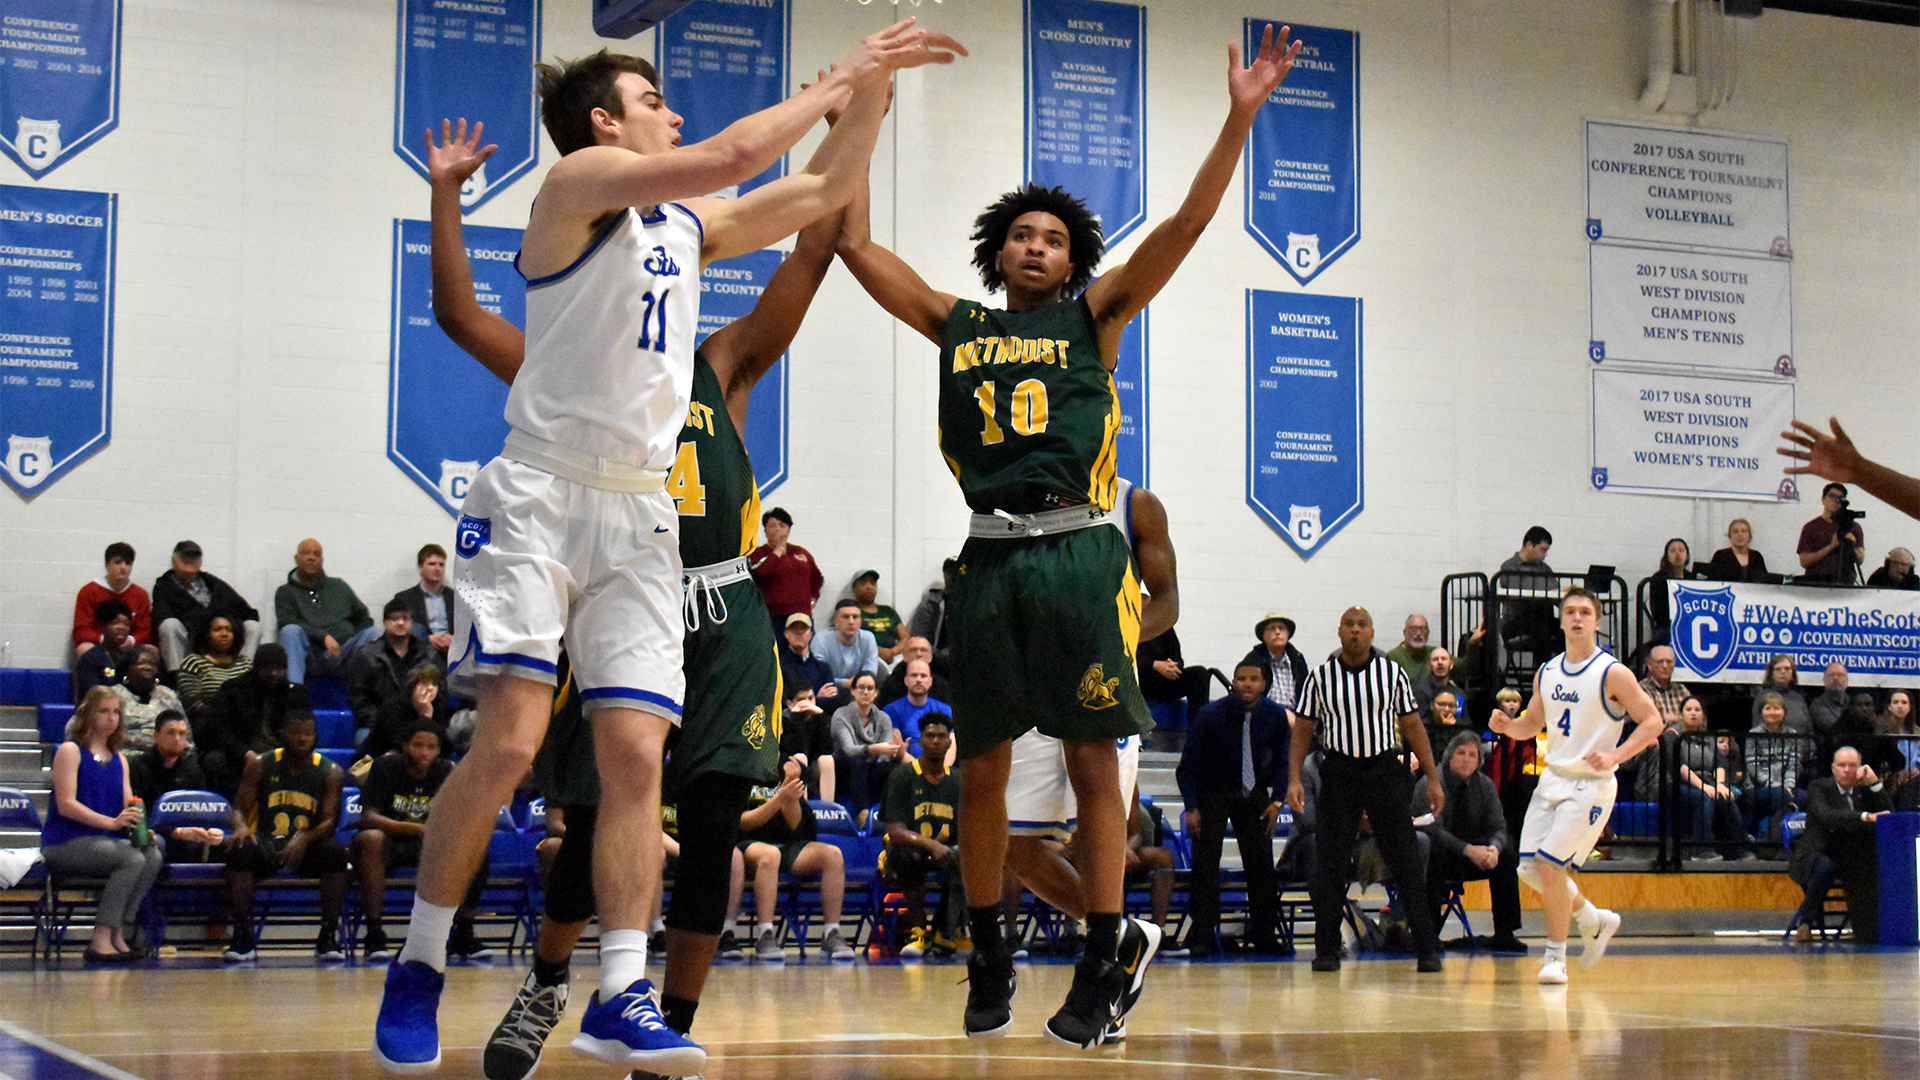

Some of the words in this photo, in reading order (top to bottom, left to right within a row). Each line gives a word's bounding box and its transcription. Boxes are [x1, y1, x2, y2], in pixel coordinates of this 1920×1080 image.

[717, 0, 775, 8] NTRY
[4, 16, 79, 32] CONFERENCE
[690, 22, 755, 37] CONFERENCE
[1068, 20, 1104, 31] MEN'S
[2, 28, 81, 44] TOURNAMENT
[683, 31, 762, 48] CHAMPIONSHIPS
[1039, 30, 1075, 43] CROSS
[1078, 34, 1132, 48] COUNTRY
[77, 63, 102, 75] 2014
[1063, 62, 1106, 74] NATIONAL
[1292, 59, 1336, 72] ETBALL
[1052, 71, 1117, 85] CHAMPIONSHIP
[1054, 82, 1116, 96] APPEARANCES
[1274, 86, 1328, 99] CONFERENCE
[1268, 95, 1336, 110] CHAMPIONSHIPS
[28, 134, 48, 159] C
[1633, 143, 1664, 157] 2017
[1667, 146, 1694, 161] USA
[1699, 149, 1745, 166] SOUTH
[1275, 159, 1330, 172] CONFERENCE
[1273, 169, 1331, 182] TOURNAMENT
[1591, 159, 1685, 181] CONFERENCE
[1689, 169, 1784, 191] TOURNAMENT
[1268, 179, 1336, 193] CHAMPIONSHIPS
[1648, 185, 1733, 205] CHAMPIONS
[46, 213, 103, 227] SOCCER
[1645, 207, 1734, 227] VOLLEYBALL
[1589, 224, 1598, 237] C
[0, 245, 74, 259] CONFERENCE
[474, 249, 517, 262] SOCCE
[1296, 248, 1310, 268] C
[703, 267, 753, 281] OMEN'S
[1636, 264, 1667, 278] 2017
[1670, 267, 1698, 281] USA
[1701, 269, 1748, 285] SOUTH
[714, 283, 765, 296] COUNTR
[1640, 285, 1681, 299] WEST
[1684, 288, 1745, 305] DIVISION
[637, 288, 670, 355] 11
[1278, 312, 1331, 326] WOMEN'S
[1651, 306, 1737, 324] CHAMPIONS
[0, 333, 71, 346] CONFERENCE
[1270, 326, 1339, 340] BASKETBALL
[1643, 326, 1689, 341] MEN'S
[1692, 329, 1745, 346] TENNIS
[953, 336, 1070, 374] METHODIST
[1276, 356, 1331, 368] CONFERENCE
[1270, 365, 1338, 378] CHAMPIONSHIPS
[1259, 380, 1278, 389] 2002
[1640, 389, 1670, 402] 2017
[1673, 391, 1701, 405] USA
[1705, 393, 1752, 408] SOUTH
[974, 378, 1049, 446] 10
[1643, 410, 1685, 425] WEST
[1688, 412, 1749, 429] DIVISION
[1276, 431, 1332, 442] CONFERENCE
[1654, 431, 1739, 449] CHAMPIONS
[1274, 441, 1333, 452] TOURNAMENT
[1270, 451, 1338, 463] CHAMPIONSHIPS
[1634, 451, 1704, 467] WOMEN'S
[1707, 455, 1759, 471] TENNIS
[19, 453, 39, 477] C
[1594, 473, 1605, 487] C
[451, 477, 468, 499] C
[462, 522, 487, 534] SCOTS
[1298, 519, 1312, 540] C
[461, 530, 480, 549] C
[1683, 598, 1727, 616] SCOTS
[1691, 616, 1719, 659] C
[1797, 631, 1920, 649] /COVENANTSCOT
[1737, 651, 1920, 670] ATHICS.COVENANT.EDU
[1551, 684, 1580, 703] Scots
[1558, 708, 1571, 737] 4
[159, 802, 227, 813] COVENANT
[813, 809, 847, 820] NANT
